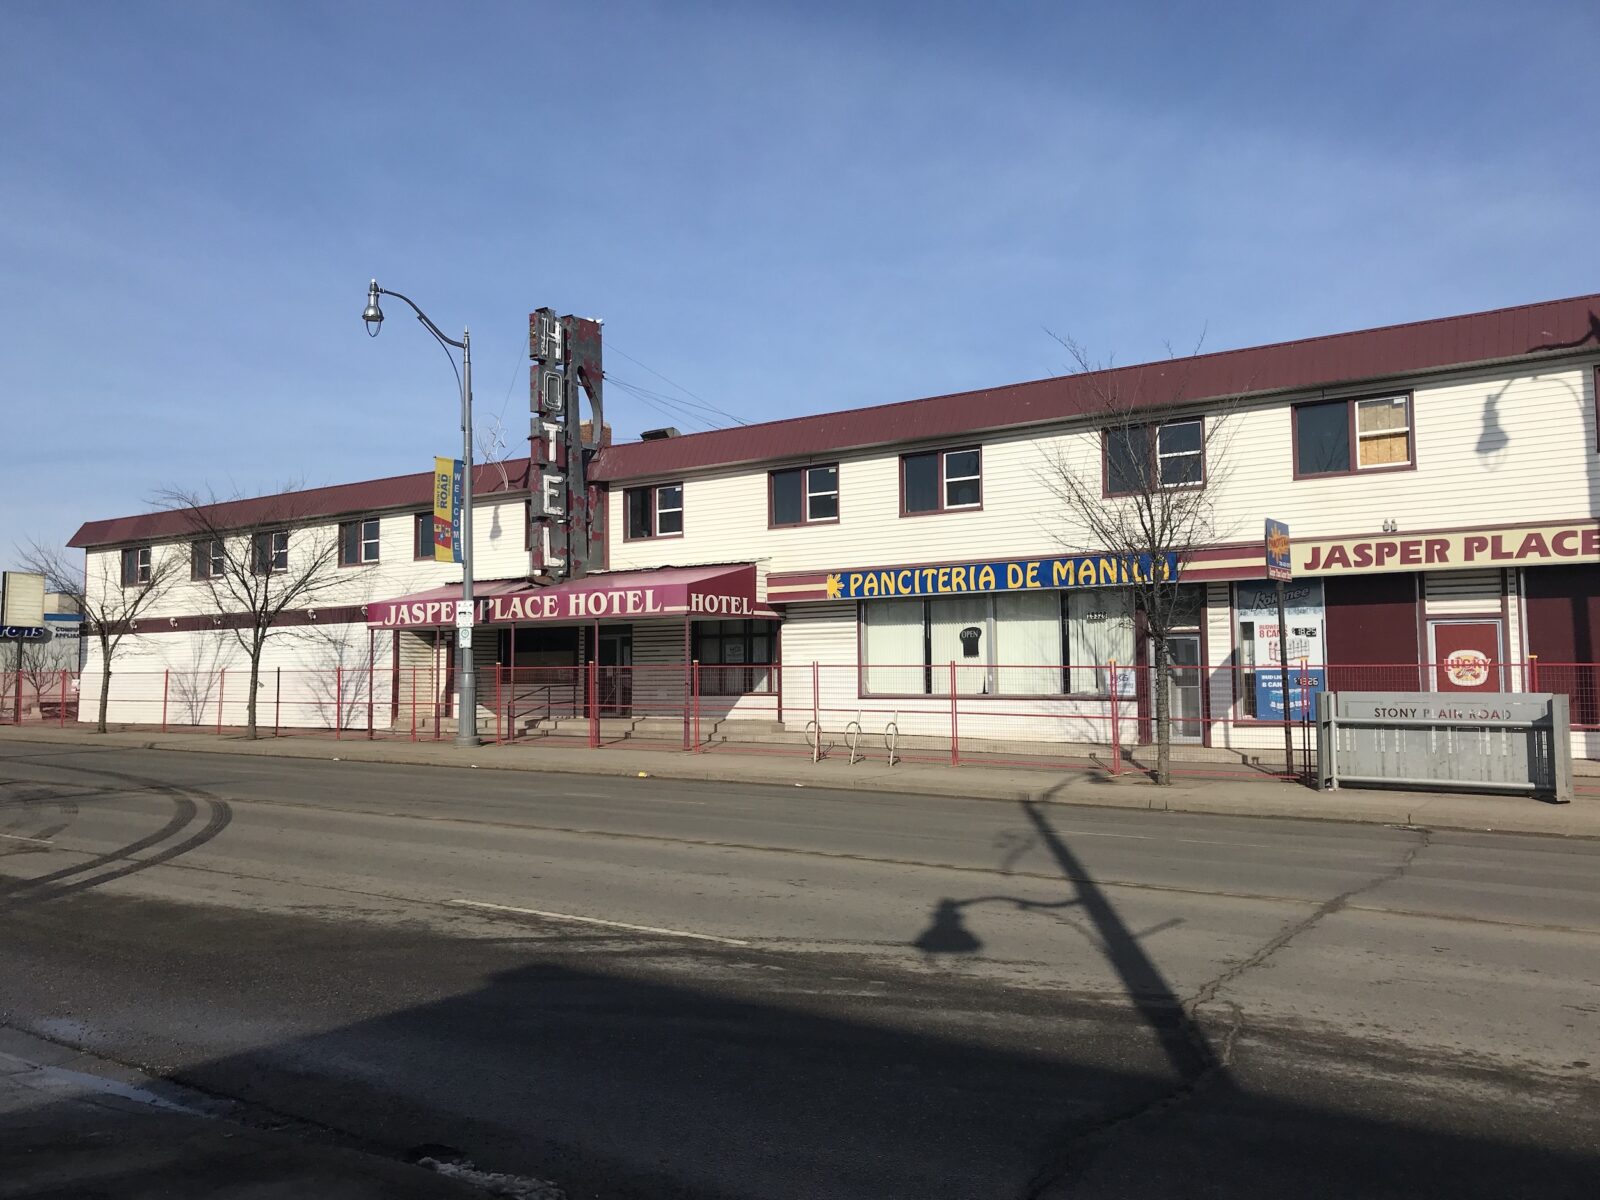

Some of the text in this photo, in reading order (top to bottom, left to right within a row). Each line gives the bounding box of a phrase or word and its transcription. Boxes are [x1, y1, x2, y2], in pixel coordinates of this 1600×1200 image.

[541, 317, 565, 568] HOTEL
[440, 474, 448, 508] ROAD
[453, 473, 461, 550] WELCOME
[1304, 538, 1450, 571] JASPER
[1464, 529, 1599, 561] PLACE
[850, 565, 996, 597] PANCITERIA
[1007, 562, 1041, 589] DE
[384, 601, 457, 626] JASPE
[479, 595, 560, 620] PLACE
[568, 589, 662, 616] HOTEL
[690, 593, 753, 615] HOTEL
[1252, 588, 1310, 611] Koknee
[961, 630, 979, 639] OPEN
[1259, 630, 1265, 638] 8
[1443, 658, 1491, 672] LUCKY
[1374, 708, 1511, 720] STONY PLAIN ROAD
